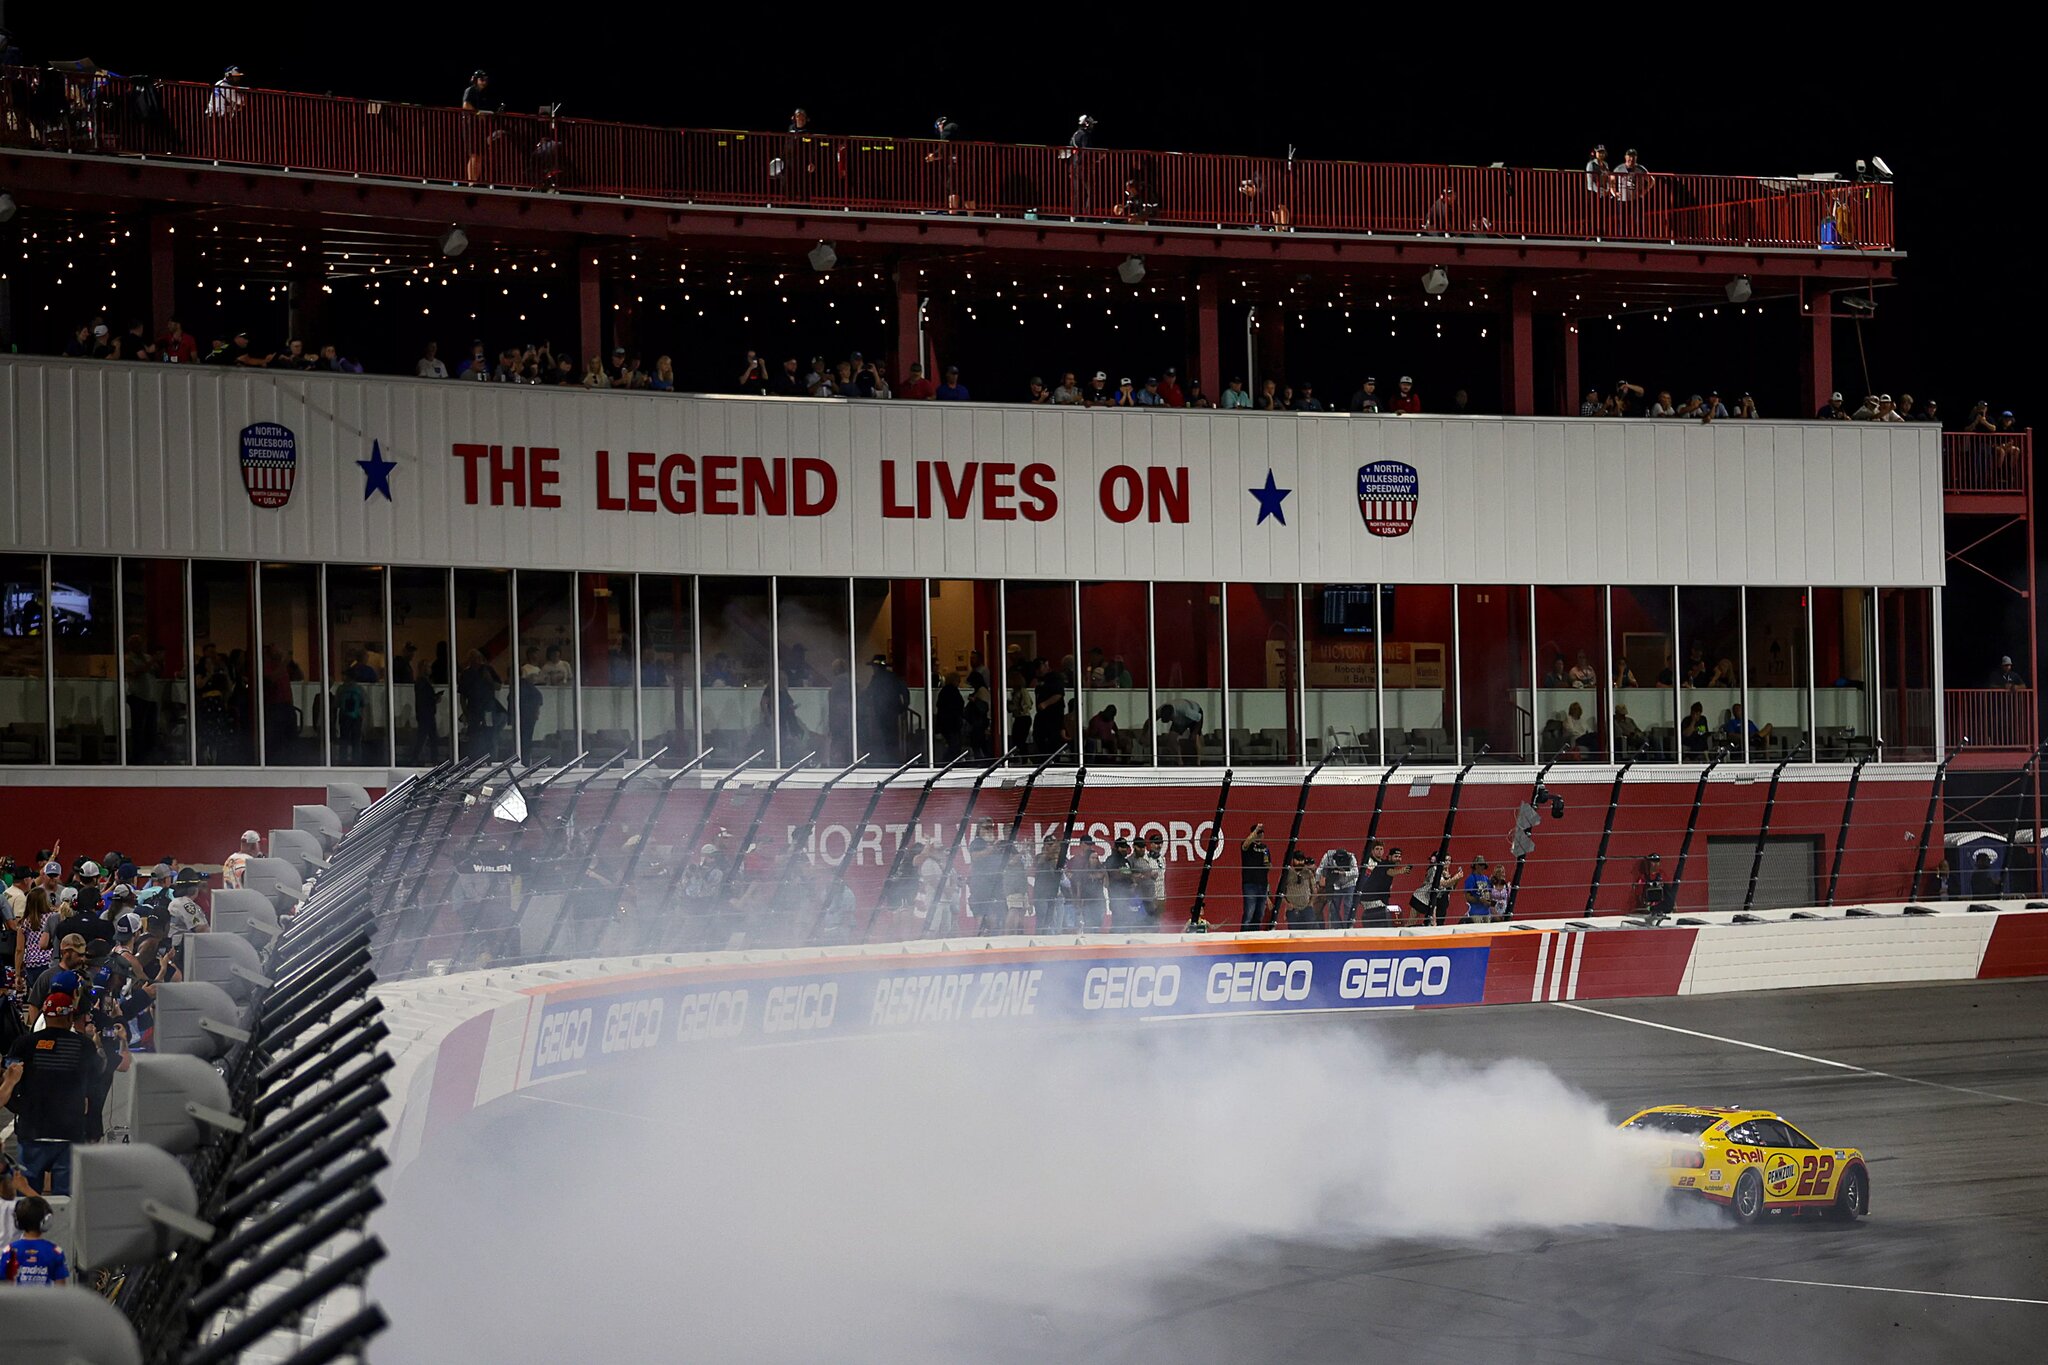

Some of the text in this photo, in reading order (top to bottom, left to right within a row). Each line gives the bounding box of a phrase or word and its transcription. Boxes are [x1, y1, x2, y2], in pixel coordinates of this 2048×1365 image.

[244, 437, 294, 448] WILKESBORO
[256, 427, 282, 436] NORTH
[249, 449, 290, 459] SPEEDWAY
[1374, 465, 1403, 473] NORTH
[452, 444, 1190, 523] THE LEGEND LIVES ON
[1361, 475, 1416, 483] WILKESBORO
[1366, 485, 1411, 493] SPEEDWAY
[1083, 964, 1181, 1009] GEICO
[1206, 959, 1313, 1003] GEICO
[1339, 956, 1451, 998] GEICO
[677, 989, 749, 1042] GEICO
[763, 982, 838, 1034] GEICO
[868, 970, 1043, 1026] RESTART ZONE
[536, 1008, 593, 1067] GEICO
[601, 997, 664, 1054] GEICO
[1726, 1148, 1764, 1165] Shell
[1767, 1164, 1795, 1184] PENNZOIL
[1796, 1155, 1835, 1196] 22
[1678, 1176, 1696, 1187] 22
